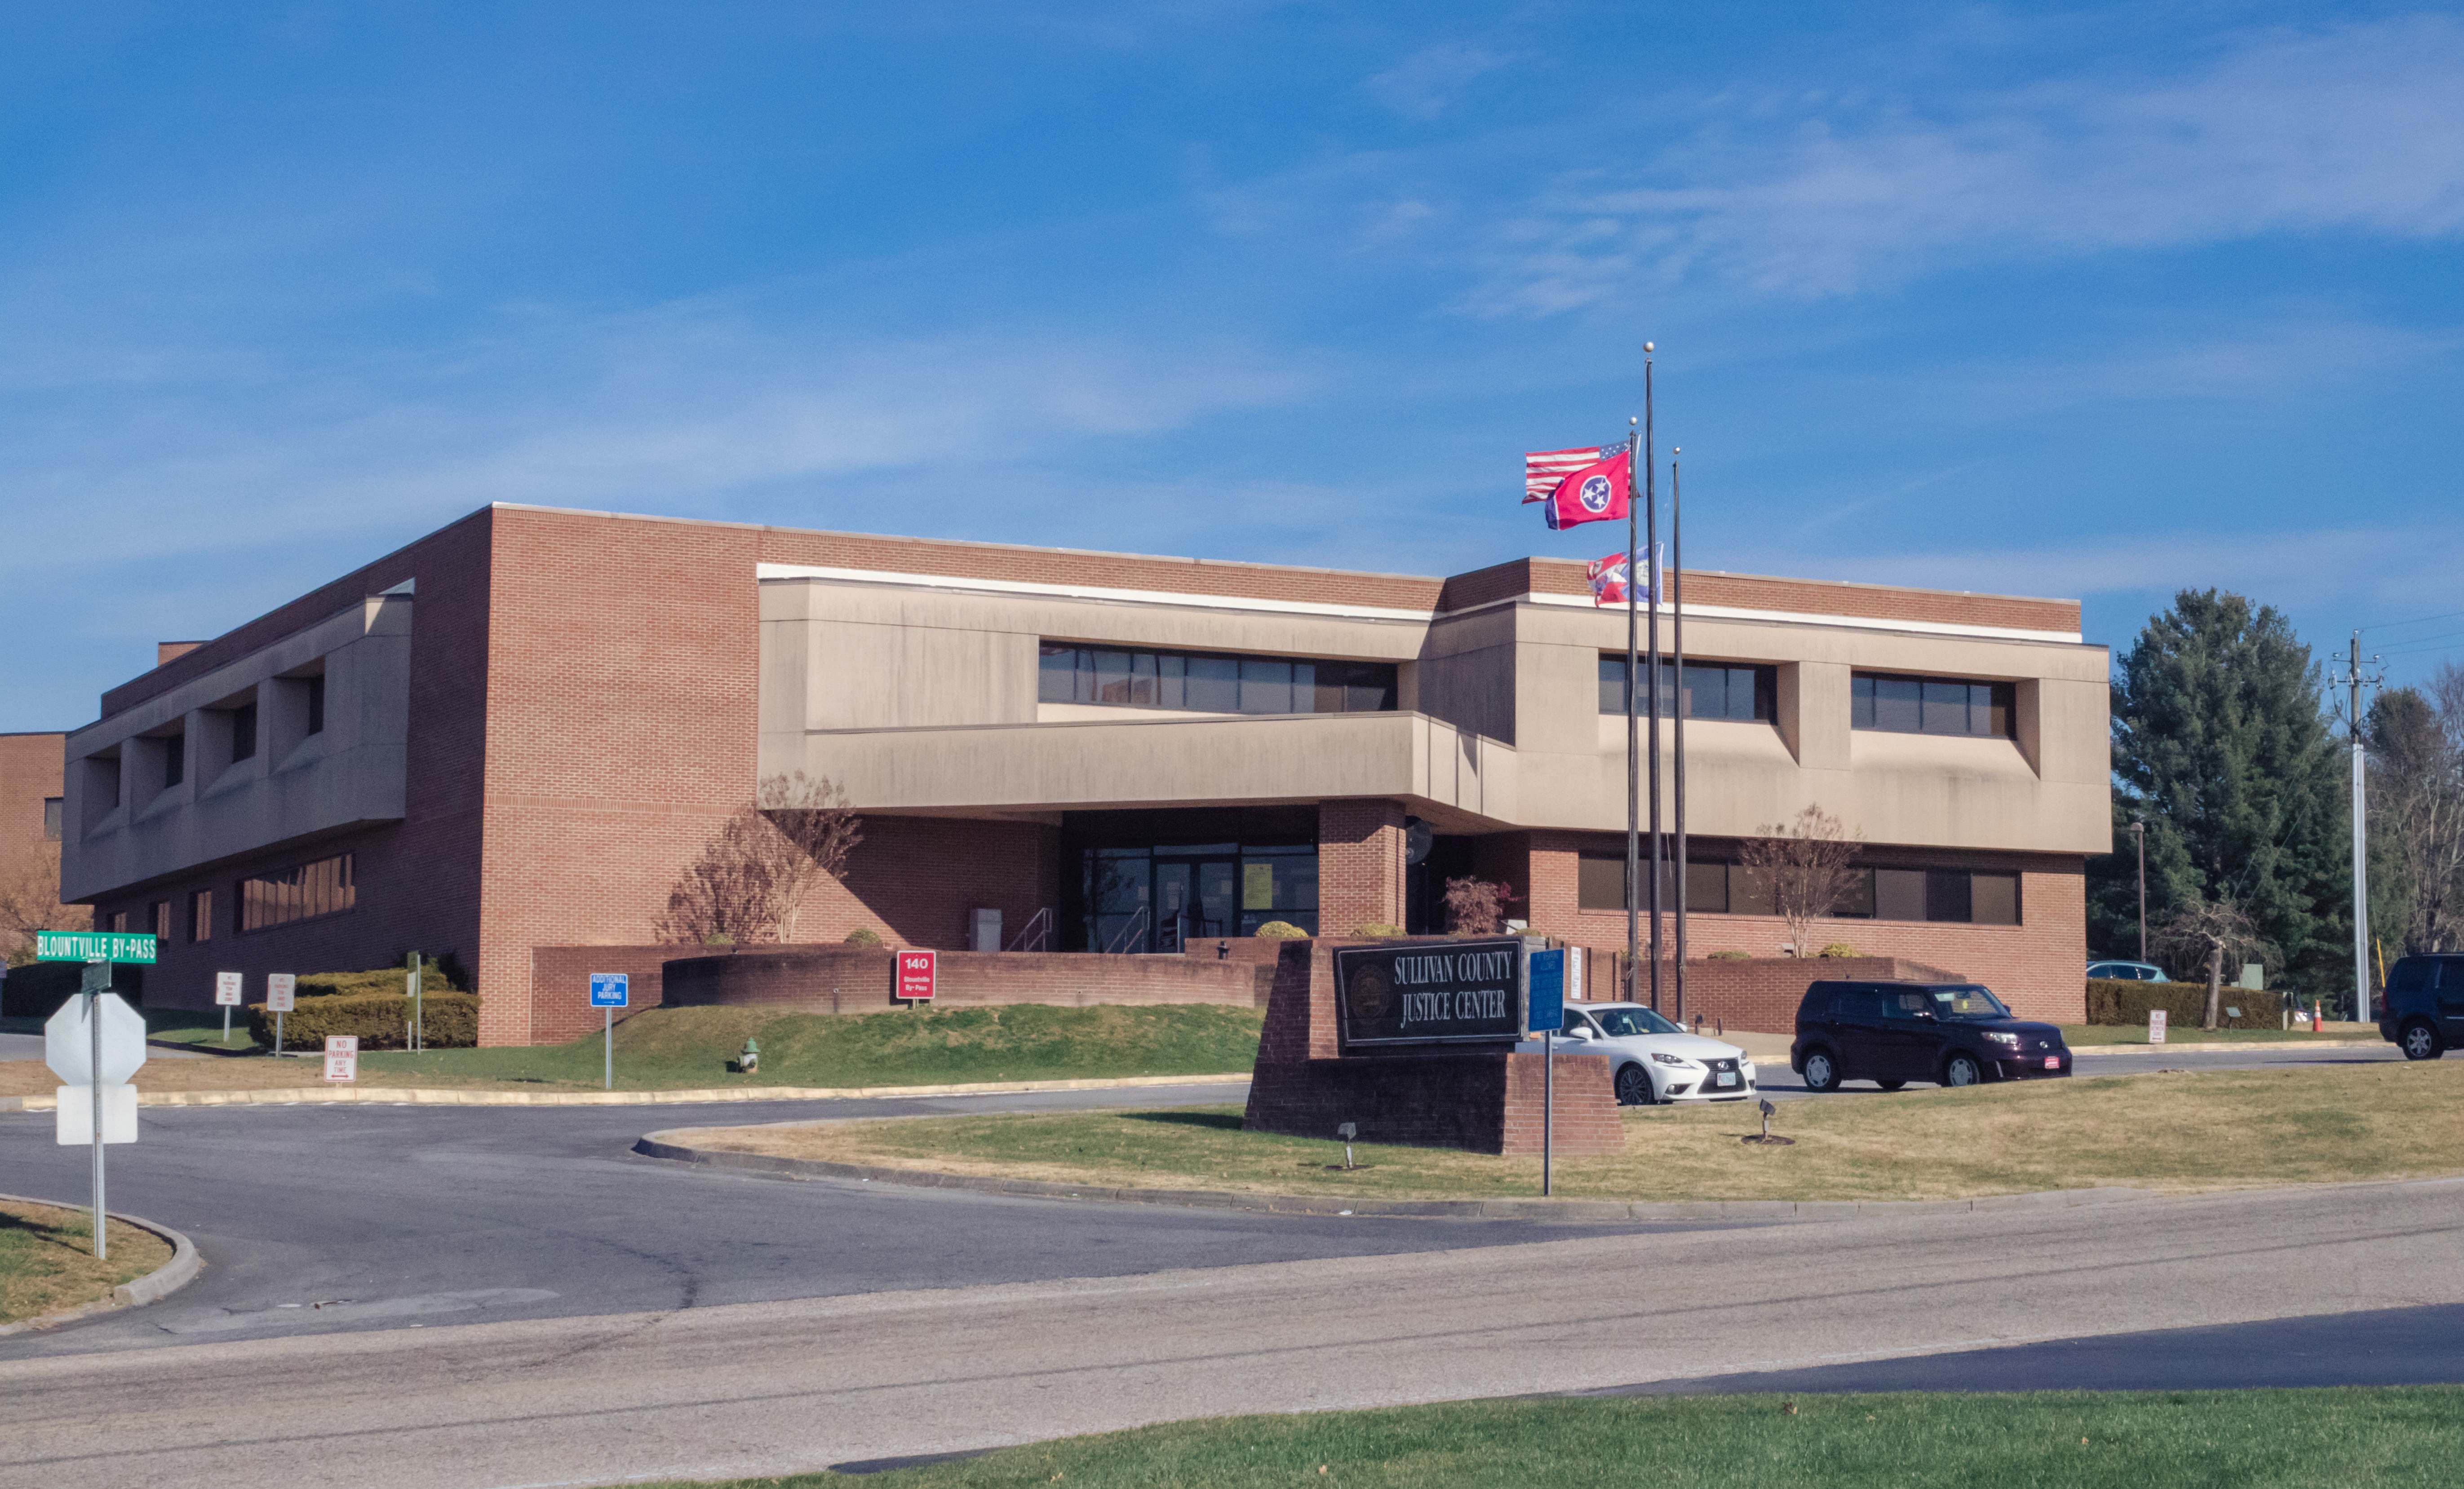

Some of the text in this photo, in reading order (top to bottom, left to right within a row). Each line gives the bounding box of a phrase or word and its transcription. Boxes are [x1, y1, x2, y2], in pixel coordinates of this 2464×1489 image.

[37, 936, 155, 959] BLOUNTVILLE BY-PASS
[905, 958, 928, 969] 140
[1395, 951, 1512, 985] SULLIVAN COUNTY
[593, 975, 626, 983] ADDITIONAL
[602, 983, 616, 992] JURY
[598, 991, 622, 999] PARKING
[1400, 992, 1450, 1029] JUSTICE
[1455, 990, 1506, 1019] CENTER
[337, 1040, 347, 1048] NO
[328, 1050, 354, 1058] PARKING
